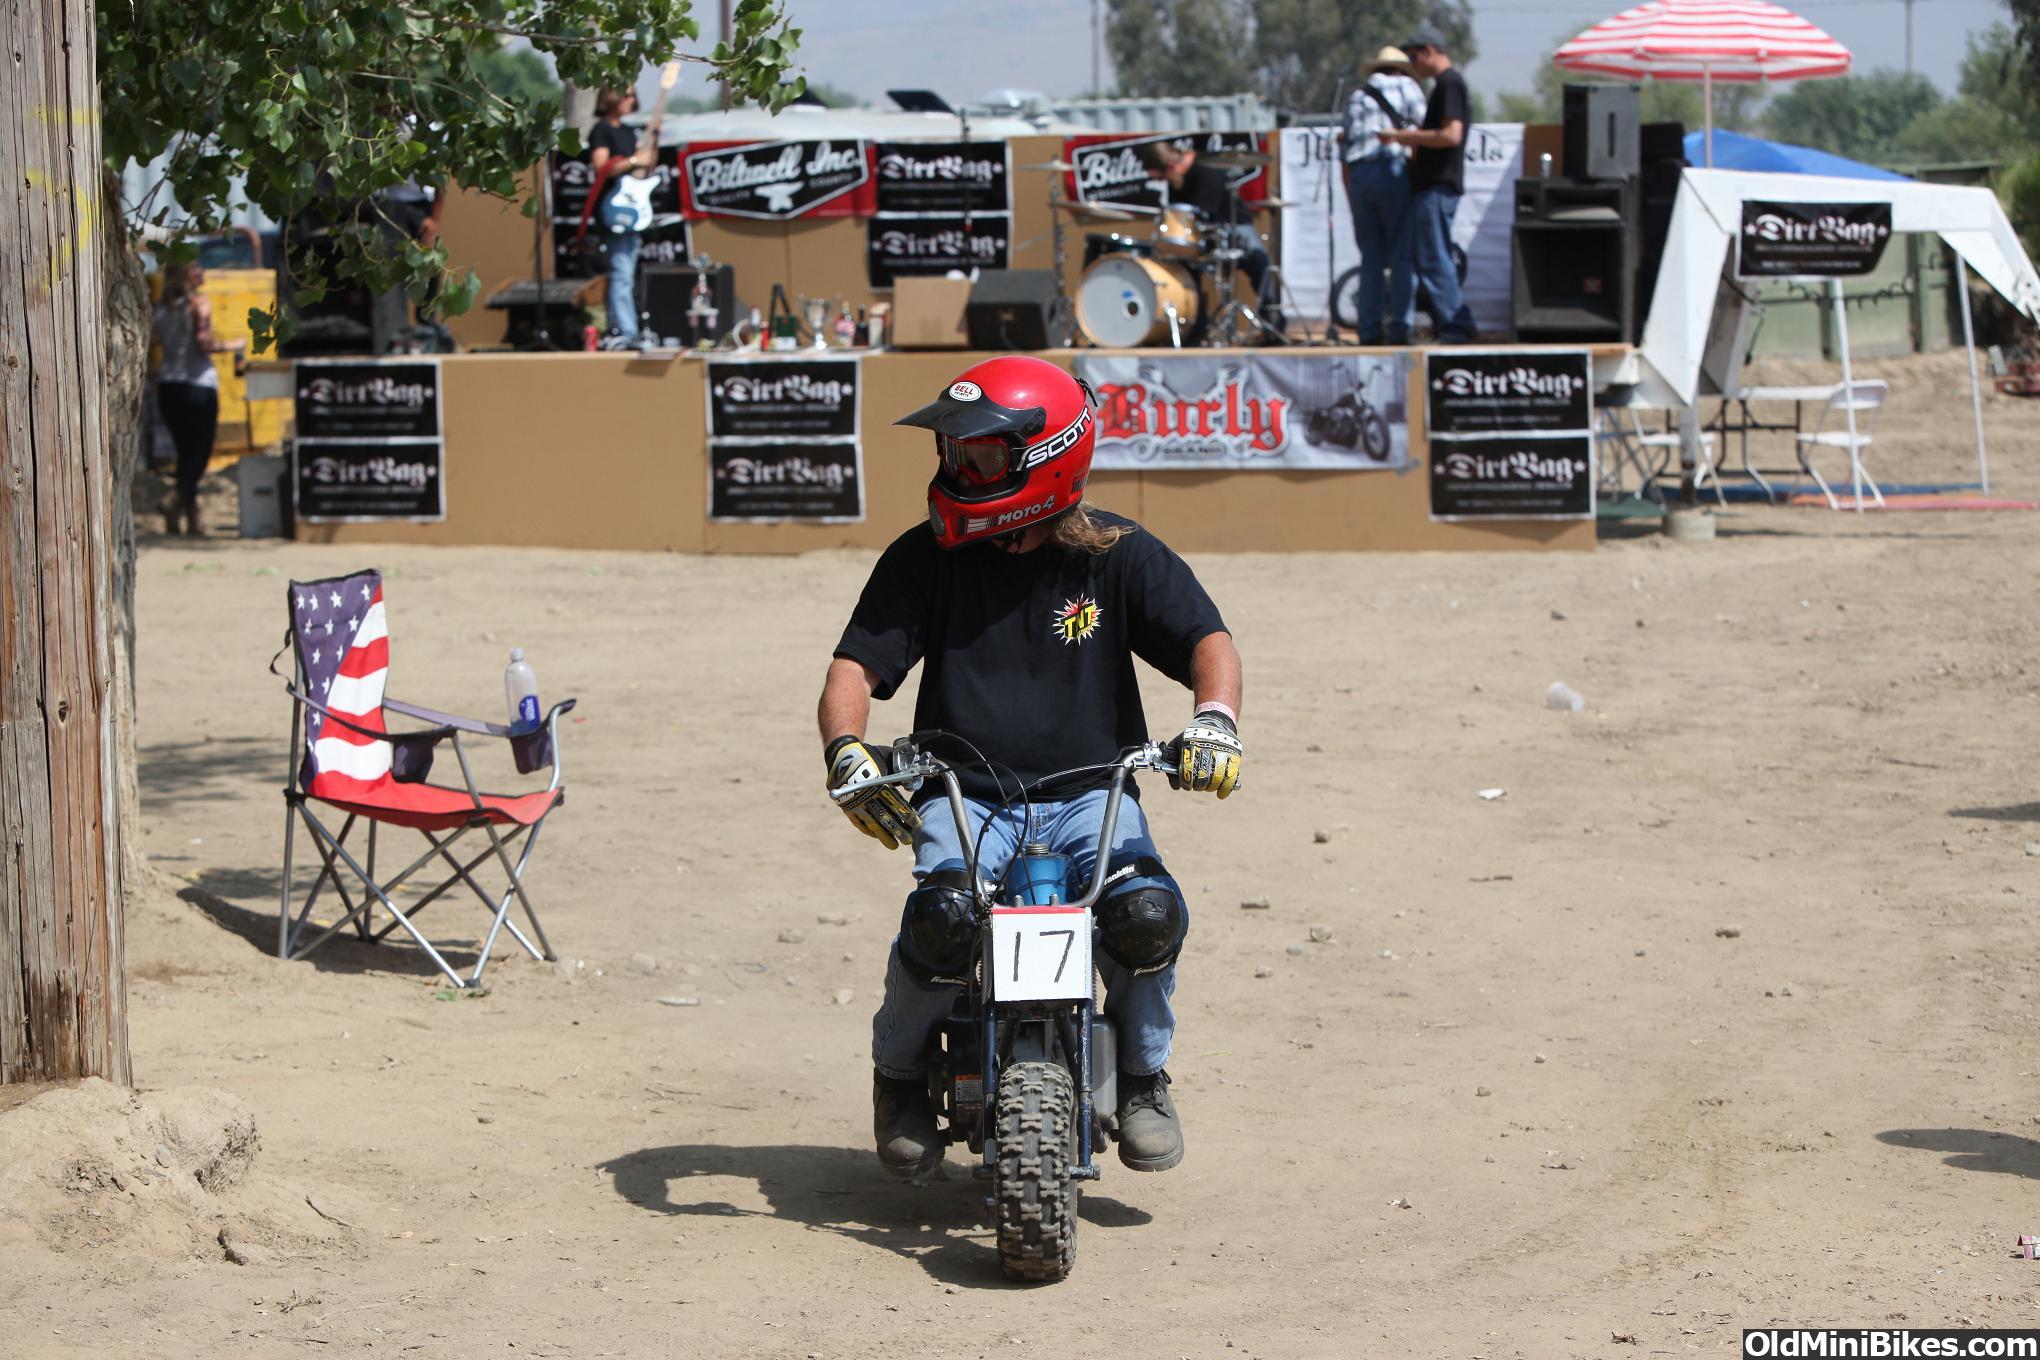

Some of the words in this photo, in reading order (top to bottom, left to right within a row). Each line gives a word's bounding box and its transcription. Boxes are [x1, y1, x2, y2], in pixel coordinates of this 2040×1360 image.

[695, 144, 804, 195] Biltwell
[954, 384, 974, 395] BELL
[1026, 407, 1092, 469] SCOTT
[1096, 381, 1288, 450] Burly
[1064, 603, 1098, 638] TNT
[1104, 865, 1136, 886] ranklin
[1013, 929, 1075, 983] 17
